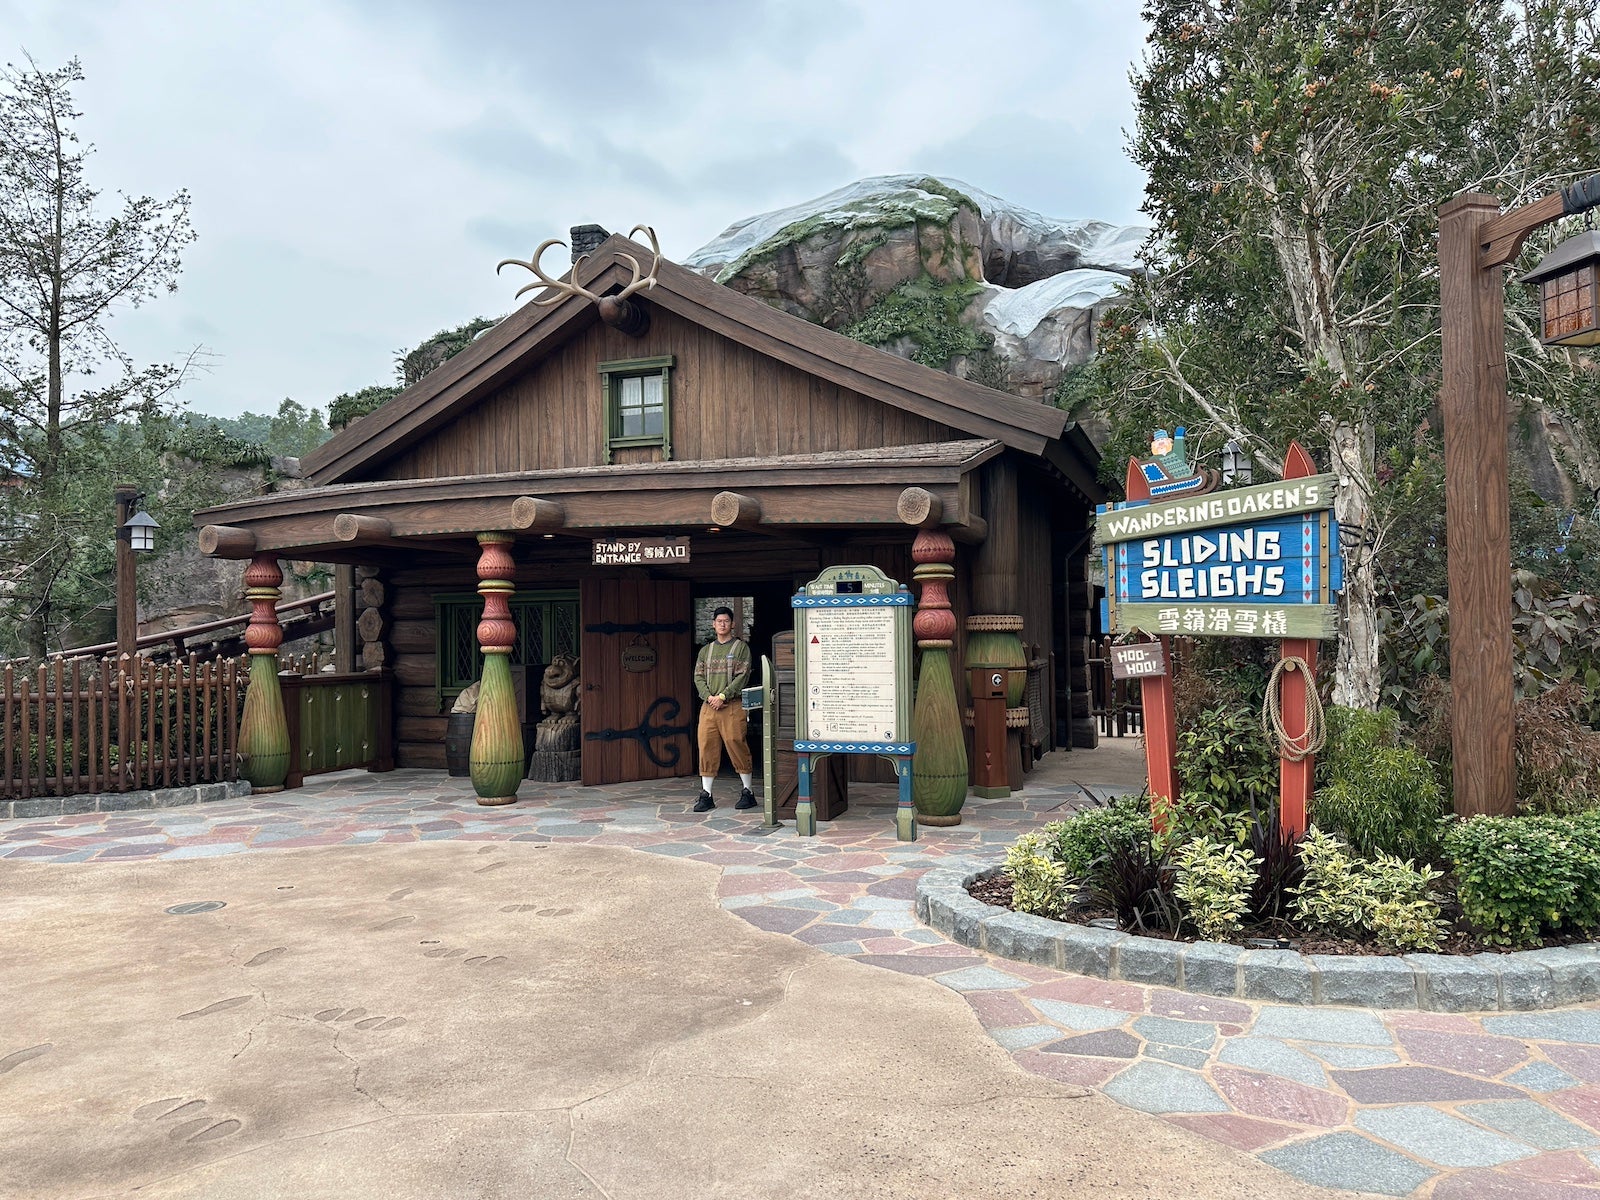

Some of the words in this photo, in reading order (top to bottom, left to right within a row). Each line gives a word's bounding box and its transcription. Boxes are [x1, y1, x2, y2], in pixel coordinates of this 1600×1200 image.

[1108, 503, 1224, 537] WANDERING
[1228, 484, 1319, 515] OAKEN'S
[596, 543, 626, 553] STAND
[628, 542, 641, 552] BY
[596, 553, 641, 563] ENTRANCE
[1142, 528, 1281, 568] SLIDING
[1141, 565, 1285, 599] SLEIGHS
[1158, 607, 1287, 635] 雪嶺滑雪橇
[1116, 650, 1149, 663] HOO-
[1126, 660, 1157, 674] HOO!
